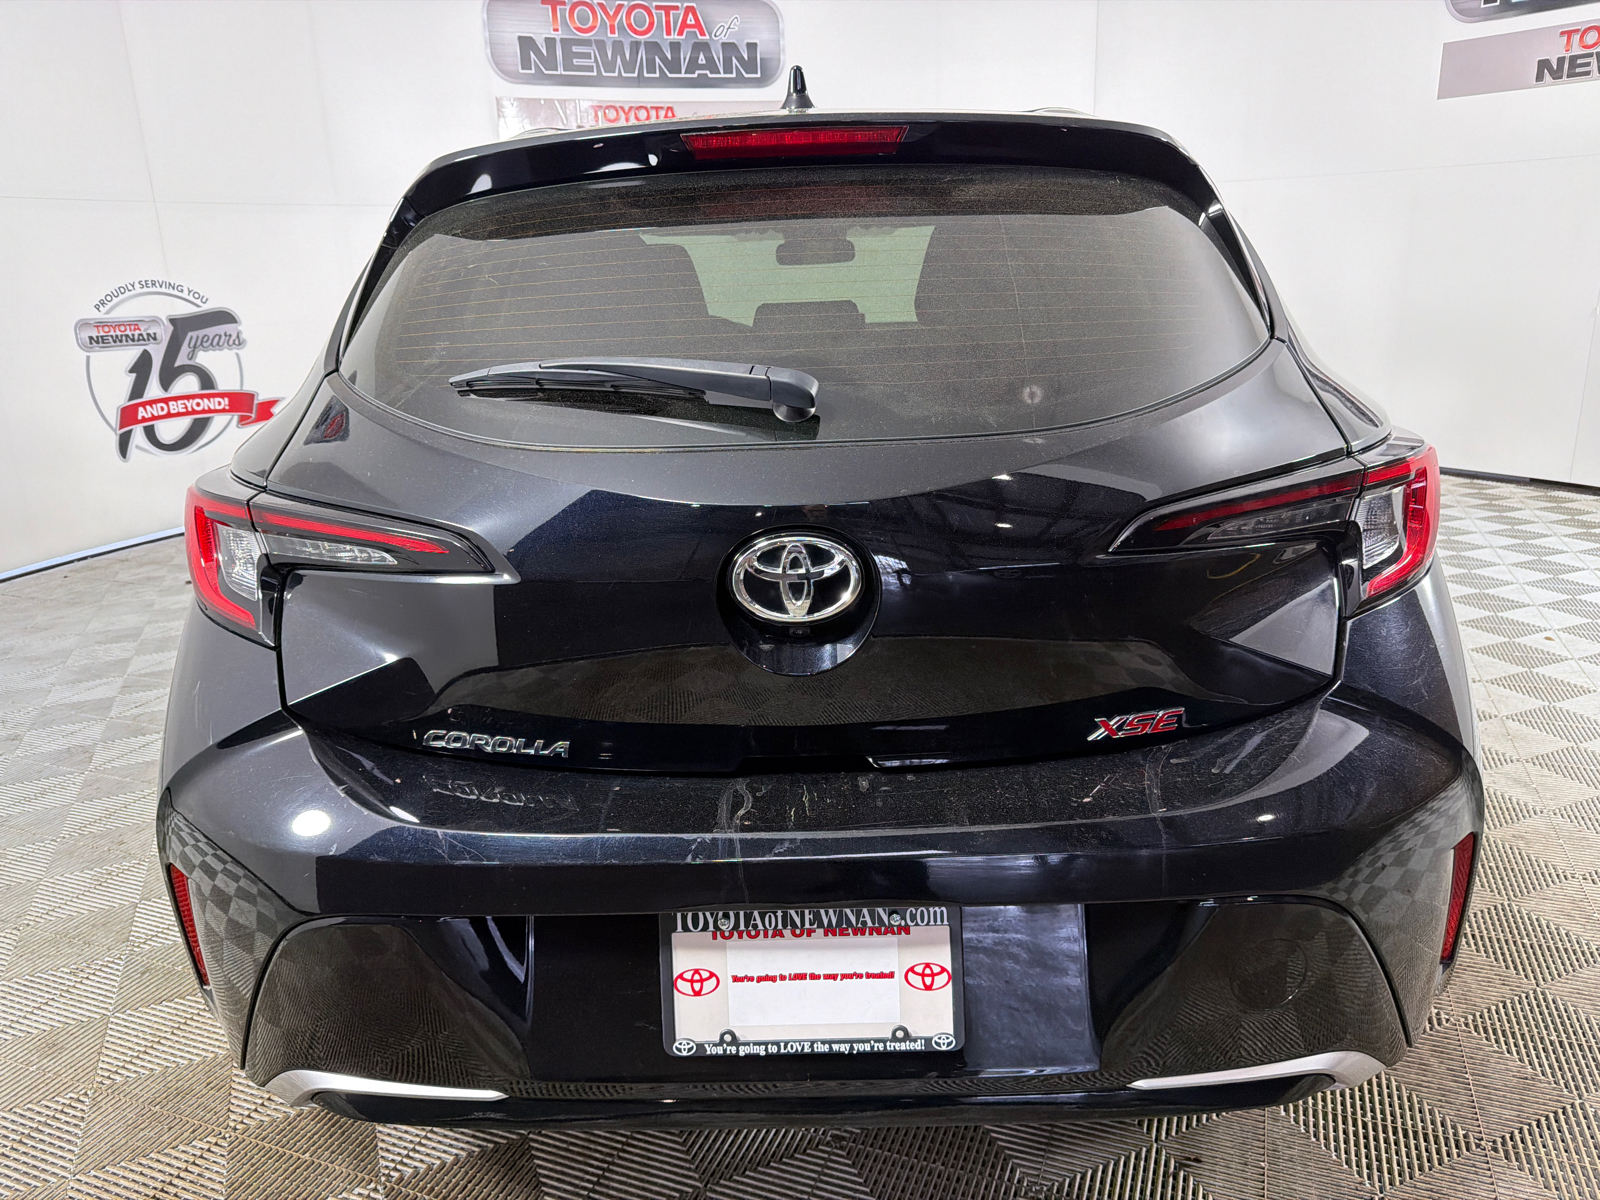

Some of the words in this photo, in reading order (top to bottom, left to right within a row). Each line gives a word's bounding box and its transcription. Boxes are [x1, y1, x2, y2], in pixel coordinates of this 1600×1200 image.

[540, 0, 708, 39] TOYOTA
[713, 15, 740, 40] of
[517, 35, 760, 77] NEWNAN
[1535, 51, 1600, 83] NE
[590, 104, 676, 123] TOYOTA
[93, 281, 136, 312] PROUDLY
[138, 279, 185, 294] SERVING
[186, 285, 210, 305] YOU
[88, 332, 158, 345] NEWNAN
[93, 323, 142, 334] TOYOTA
[187, 331, 244, 361] years
[137, 405, 169, 420] AND
[169, 397, 230, 414] BEYOND!
[1087, 707, 1185, 741] XSE
[423, 729, 571, 758] COROLLA
[704, 1043, 737, 1054] You're
[739, 1042, 766, 1056] going
[768, 1043, 778, 1053] to
[780, 1041, 812, 1053] LOVE
[813, 1041, 830, 1052] the
[831, 1043, 851, 1054] way
[853, 1040, 885, 1054] you're
[886, 1039, 925, 1050] treated!
